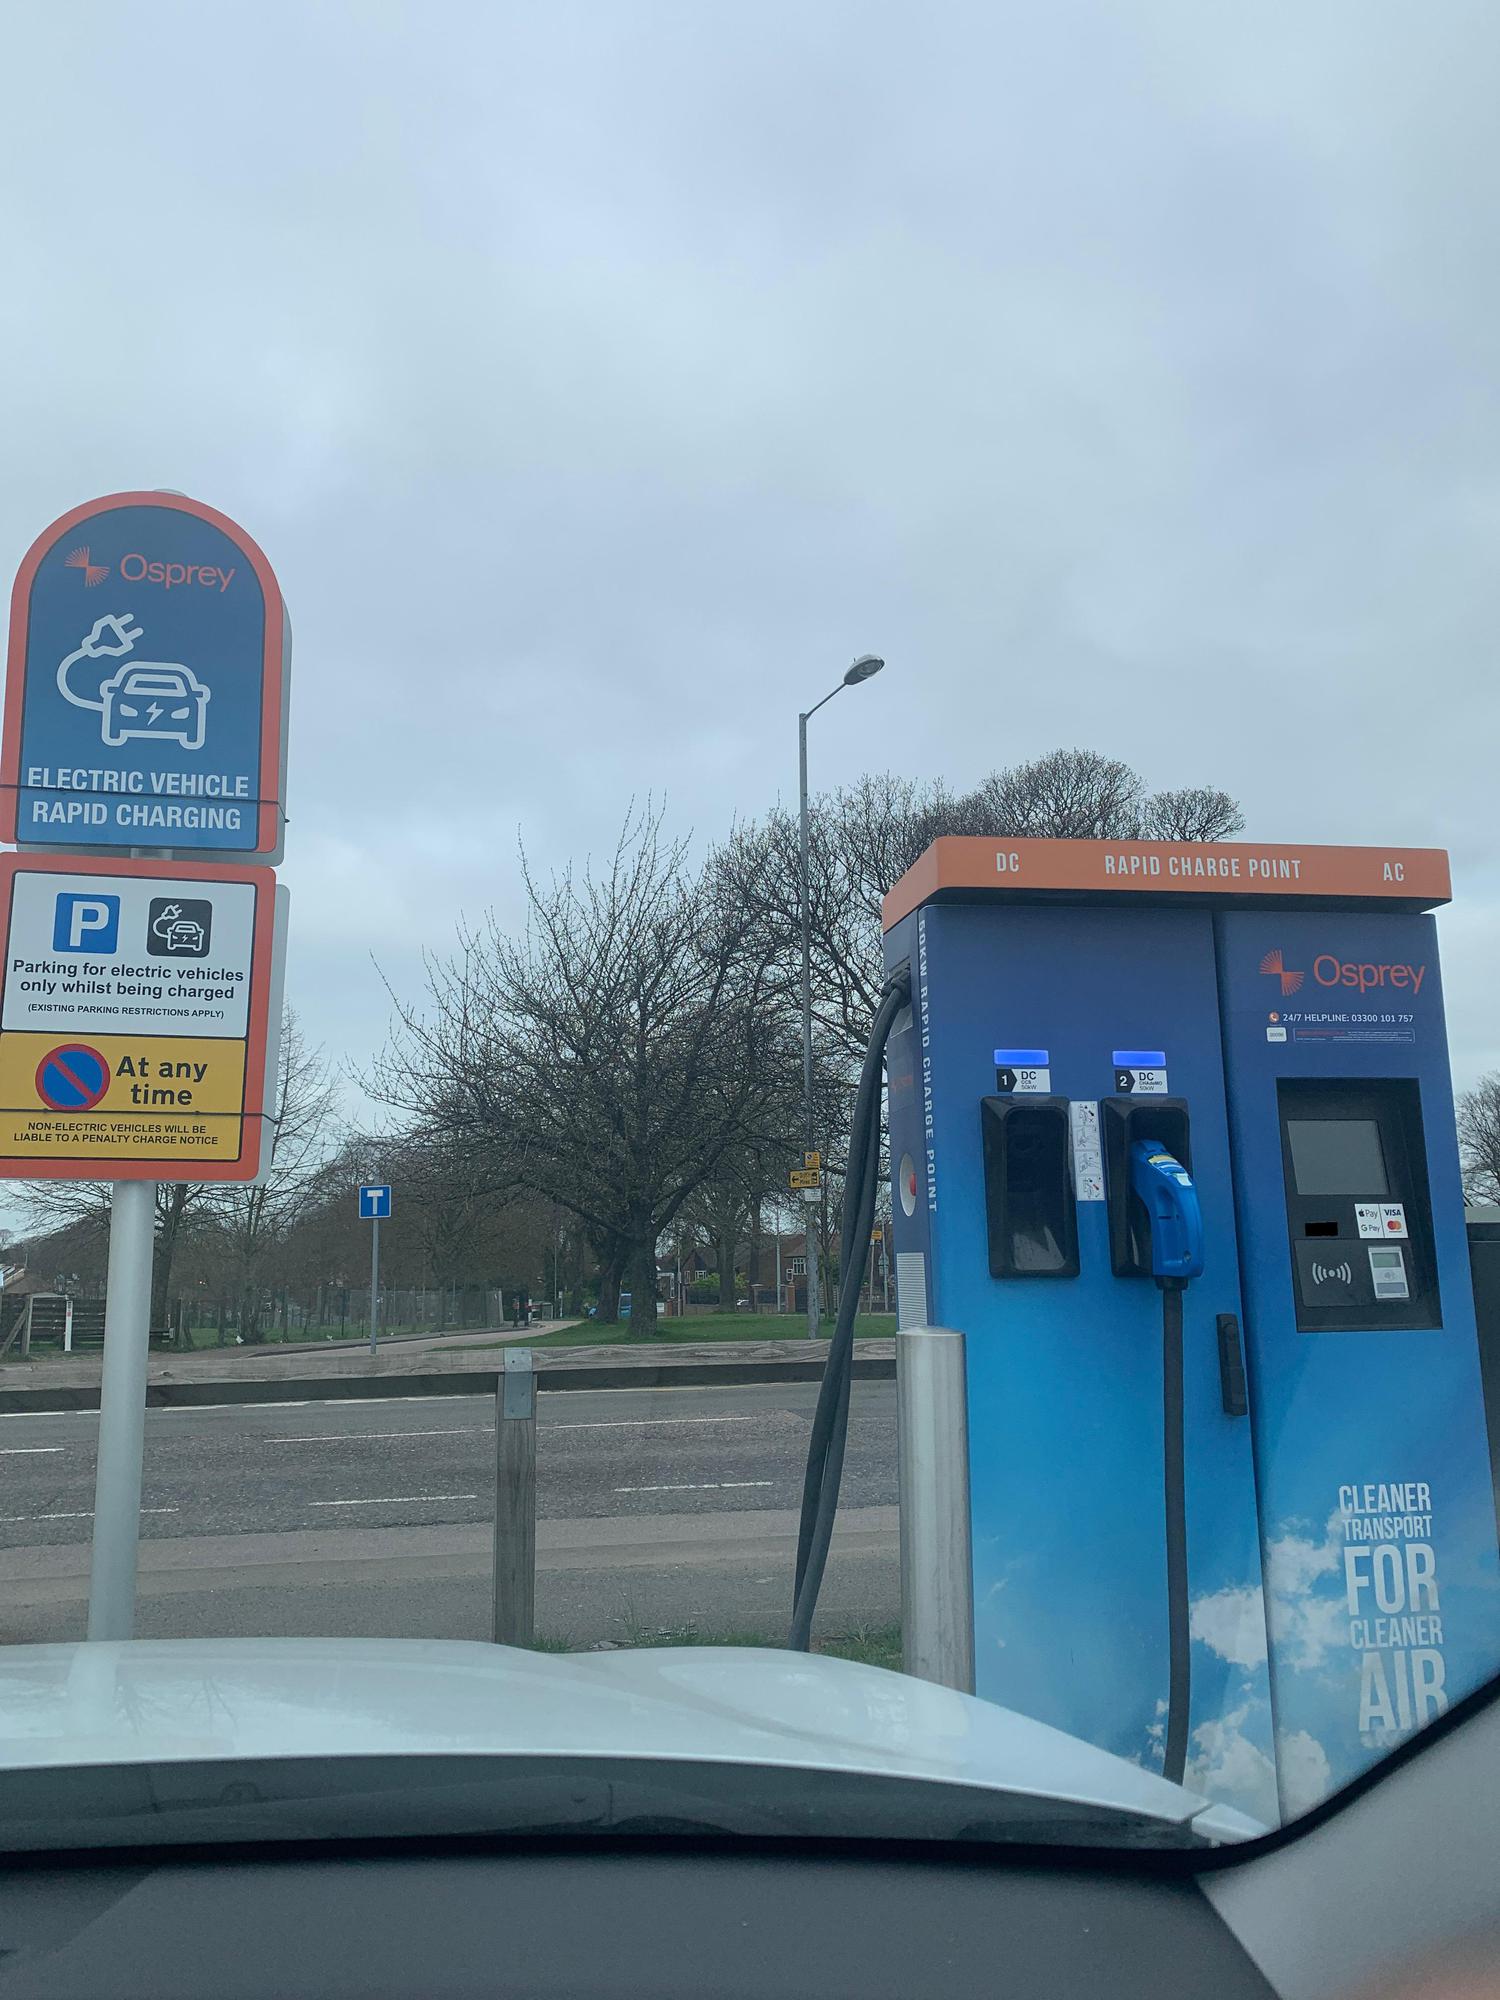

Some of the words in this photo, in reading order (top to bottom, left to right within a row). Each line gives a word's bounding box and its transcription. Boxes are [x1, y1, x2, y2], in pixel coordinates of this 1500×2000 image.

[120, 553, 235, 592] Osprey
[28, 767, 144, 794] ELECTRIC
[150, 772, 249, 797] VEHICLE
[32, 801, 108, 825] RAPID
[116, 804, 241, 830] CHARGING
[996, 852, 1019, 873] DC
[1104, 855, 1160, 875] RAPID
[1169, 856, 1241, 877] CHARGE
[1249, 859, 1301, 879] POINT
[1383, 863, 1405, 881] AC
[69, 900, 110, 947] P
[13, 959, 78, 978] Parking
[83, 962, 107, 976] for
[111, 963, 172, 979] electric
[177, 967, 244, 981] vehicles
[1313, 954, 1425, 994] Osprey
[20, 979, 57, 995] only
[62, 980, 112, 994] whilst
[117, 982, 162, 999] being
[168, 984, 234, 1001] charged
[28, 1003, 75, 1013] (EXISTING
[77, 1005, 119, 1014] PARKING
[121, 1007, 190, 1017] RESTRICTIONS
[191, 1009, 224, 1019] APPLY)
[920, 985, 930, 1048] RAPID
[1282, 1013, 1301, 1022] 24/7
[1304, 1014, 1350, 1022] HELPLINE:
[1351, 1014, 1378, 1022] 03300
[1381, 1014, 1396, 1022] 101
[1398, 1014, 1413, 1023] 757
[116, 1055, 149, 1077] At
[159, 1060, 208, 1083] any
[1001, 1075, 1008, 1086] 1
[1021, 1071, 1037, 1080] DC
[1119, 1075, 1128, 1087] 2
[1139, 1072, 1154, 1081] DC
[131, 1084, 193, 1106] time
[922, 1057, 934, 1139] CHARGE
[14, 1133, 51, 1142] LIABLE
[55, 1133, 70, 1142] TO
[71, 1134, 79, 1142] A
[82, 1134, 130, 1143] PENALTY
[132, 1135, 177, 1144] CHARGE
[179, 1136, 218, 1145] NOTICE
[28, 1122, 107, 1132] NON-ELECTRIC
[110, 1124, 162, 1133] VEHICLES
[164, 1125, 189, 1133] WILL
[192, 1125, 206, 1134] BE
[926, 1149, 938, 1212] POINT
[1365, 1209, 1378, 1219] Pay
[1339, 1482, 1432, 1514] CLEANER
[1342, 1515, 1432, 1540] TRANSPORT
[1343, 1543, 1440, 1616] FOR
[1350, 1615, 1443, 1650] CLEANER
[1358, 1648, 1449, 1731] AIR
